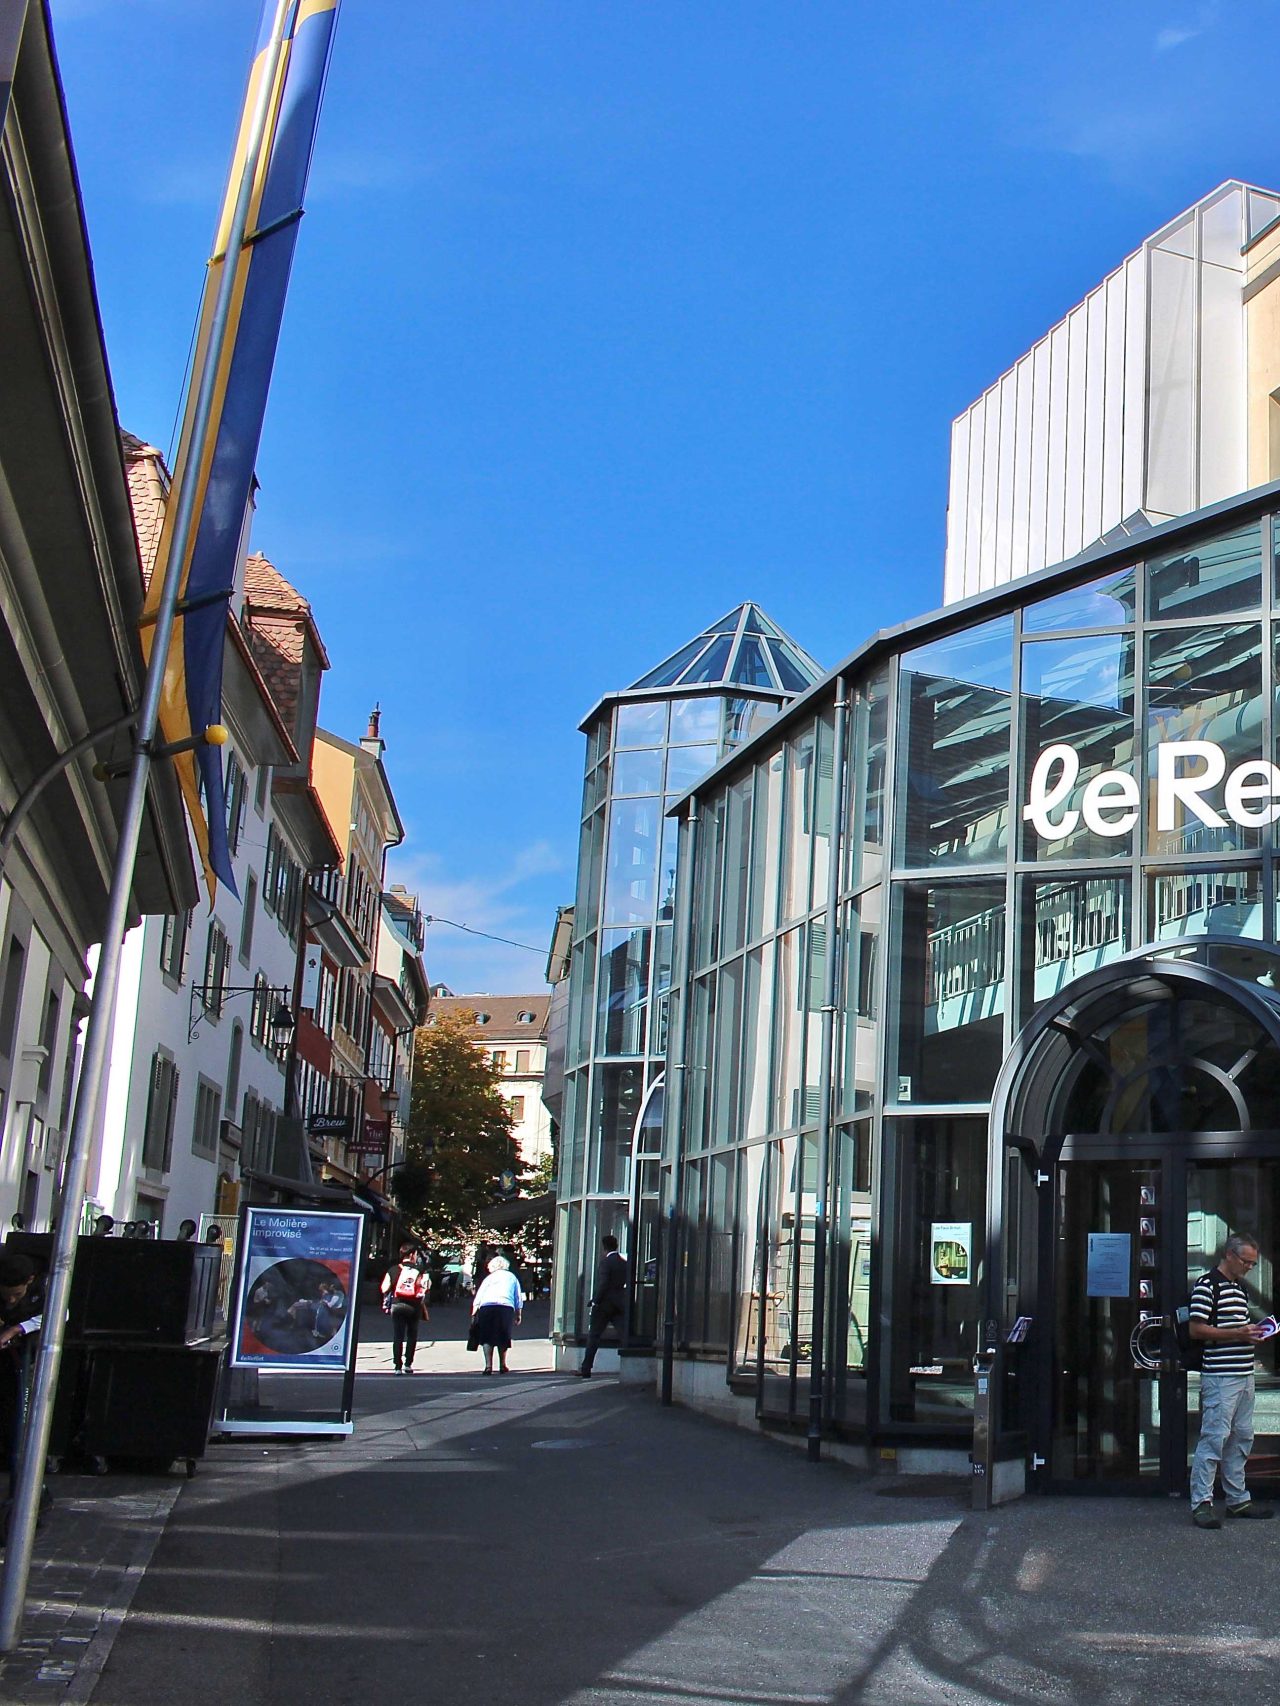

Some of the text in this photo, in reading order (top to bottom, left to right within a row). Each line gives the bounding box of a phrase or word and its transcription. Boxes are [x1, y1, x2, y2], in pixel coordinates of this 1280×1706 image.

[1021, 743, 1140, 840] le
[313, 1117, 346, 1127] Brew
[254, 1218, 308, 1229] Le Molière
[252, 1227, 302, 1239] improvisé
